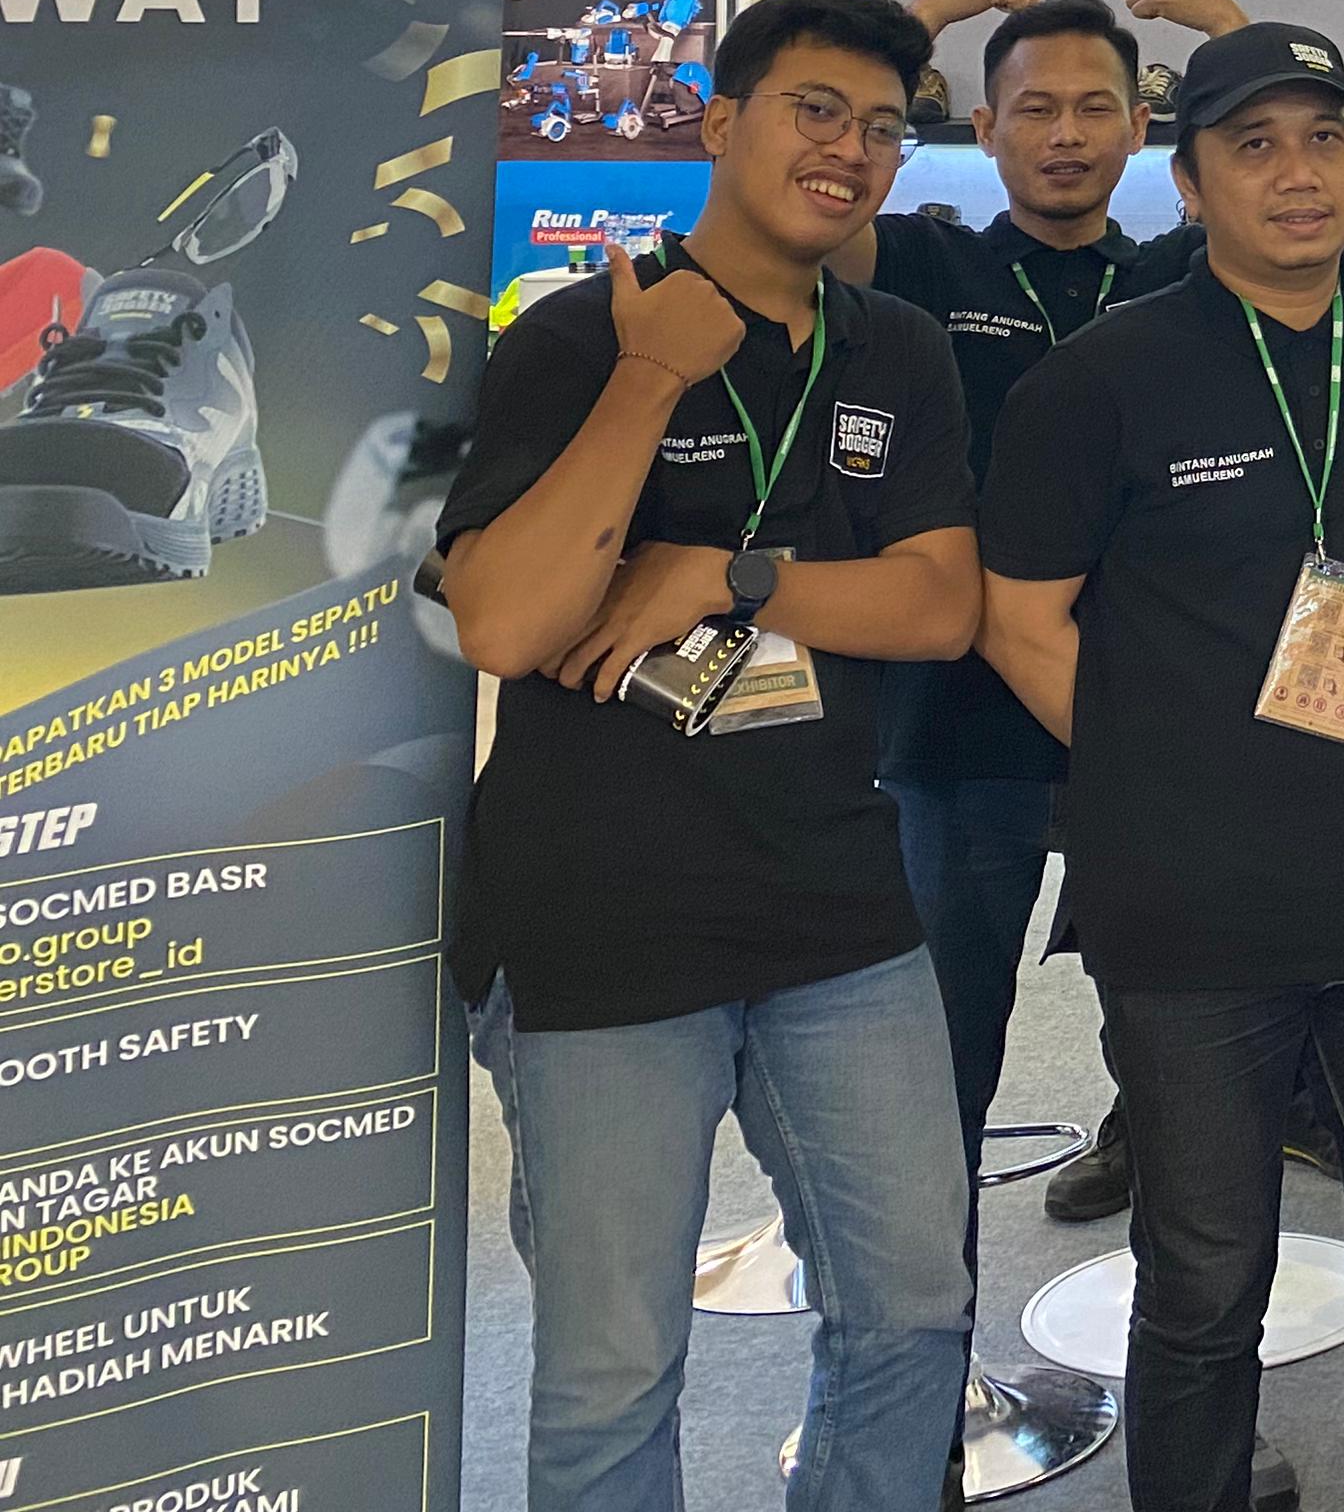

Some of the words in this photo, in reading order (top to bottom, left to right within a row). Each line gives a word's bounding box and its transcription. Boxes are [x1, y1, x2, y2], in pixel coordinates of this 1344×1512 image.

[532, 209, 582, 228] Run
[536, 232, 601, 242] Professional
[991, 315, 1043, 333] ANUGRAH
[838, 432, 883, 458] JOGGER
[839, 414, 887, 440] SAFETY
[1169, 458, 1216, 473] BINTANG
[1218, 447, 1274, 467] ANUGRAH
[1171, 468, 1244, 487] SAMUELRENO
[0, 677, 151, 766] APATKAN
[159, 668, 175, 692] 3
[183, 629, 285, 684] MODEL
[290, 579, 399, 644] SEPATU
[134, 692, 201, 736] TIAP
[207, 640, 341, 708] HARINYA
[347, 621, 379, 653] !!!
[738, 675, 796, 695] XHIBITOR
[167, 862, 268, 899] BASR
[119, 1013, 259, 1061] SAFETY
[0, 1163, 98, 1205] ANDA
[109, 1149, 152, 1180] KE
[160, 1129, 259, 1169] AKUN
[268, 1105, 415, 1149] SOCMED
[36, 1176, 157, 1224] TAGAR
[2, 1193, 195, 1260] INDONESIA
[0, 1322, 114, 1370] WHEEL
[123, 1286, 252, 1341] UNTUK
[2, 1350, 151, 1409] HADIAH
[160, 1310, 330, 1370] MENARIK
